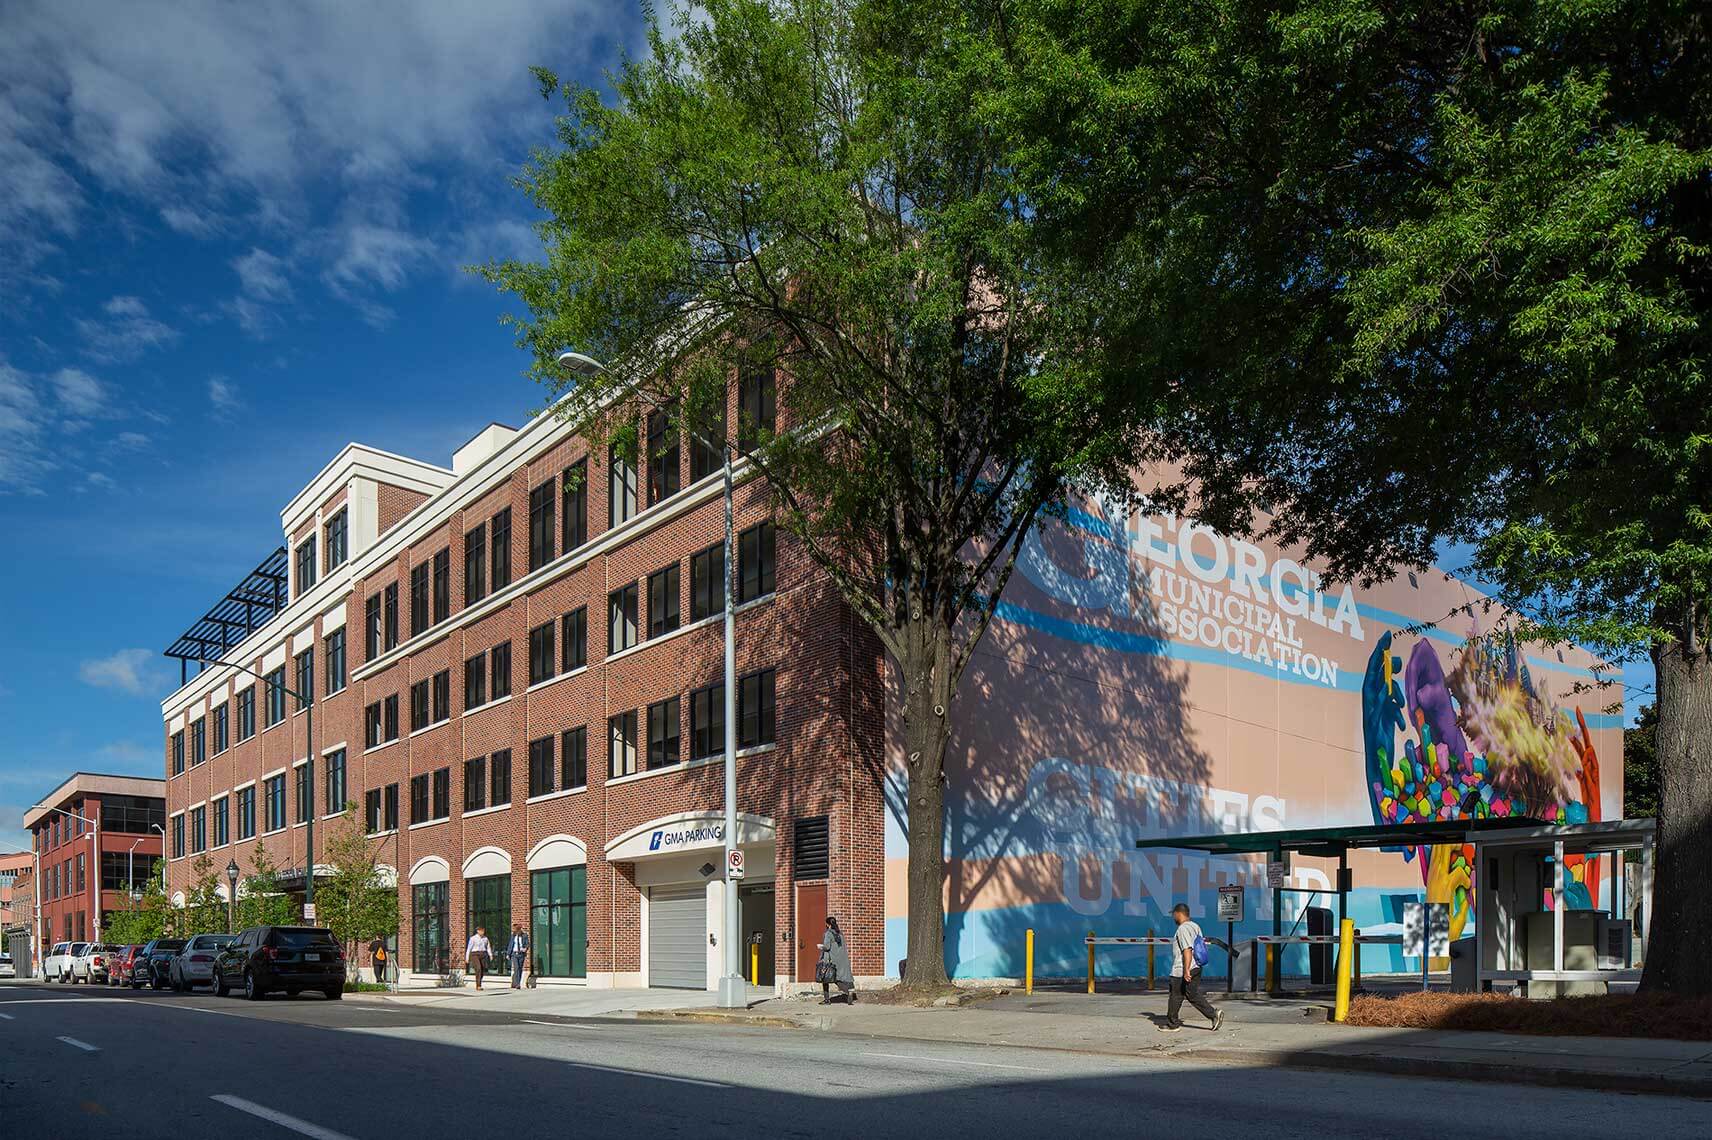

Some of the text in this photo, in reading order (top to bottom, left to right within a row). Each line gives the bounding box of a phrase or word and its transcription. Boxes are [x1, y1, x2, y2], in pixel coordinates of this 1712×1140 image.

[999, 462, 1364, 641] GEORGIA
[1133, 560, 1303, 649] MUNICIPAL
[664, 826, 722, 846] GMA PARKING
